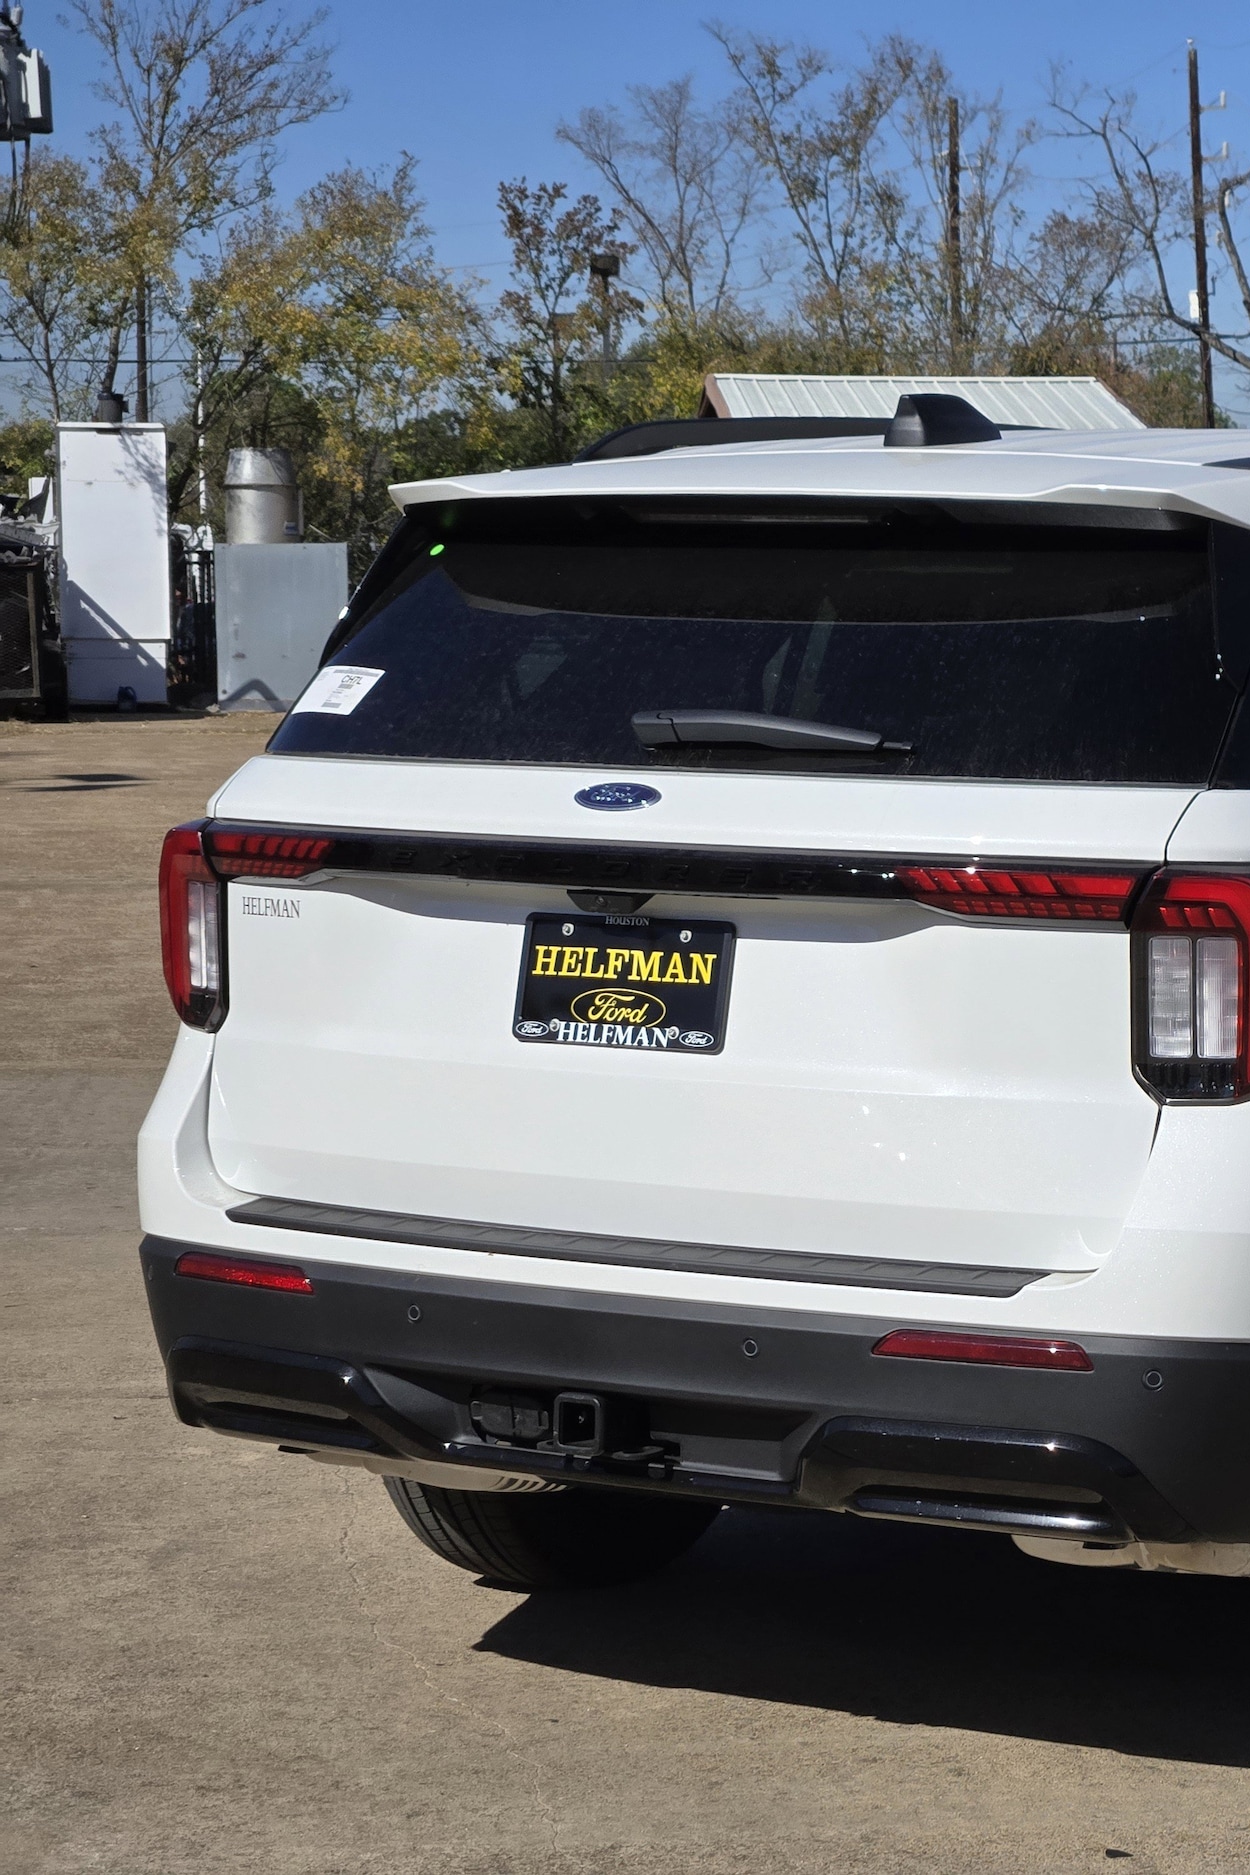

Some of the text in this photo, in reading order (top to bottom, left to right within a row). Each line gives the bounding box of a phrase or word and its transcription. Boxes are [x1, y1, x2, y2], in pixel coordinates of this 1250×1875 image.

[242, 896, 301, 919] HELFMAN
[605, 915, 650, 926] HOUSTON
[532, 945, 717, 985] HELFMAN
[588, 992, 649, 1024] Ford
[557, 1021, 670, 1048] HELFMAN
